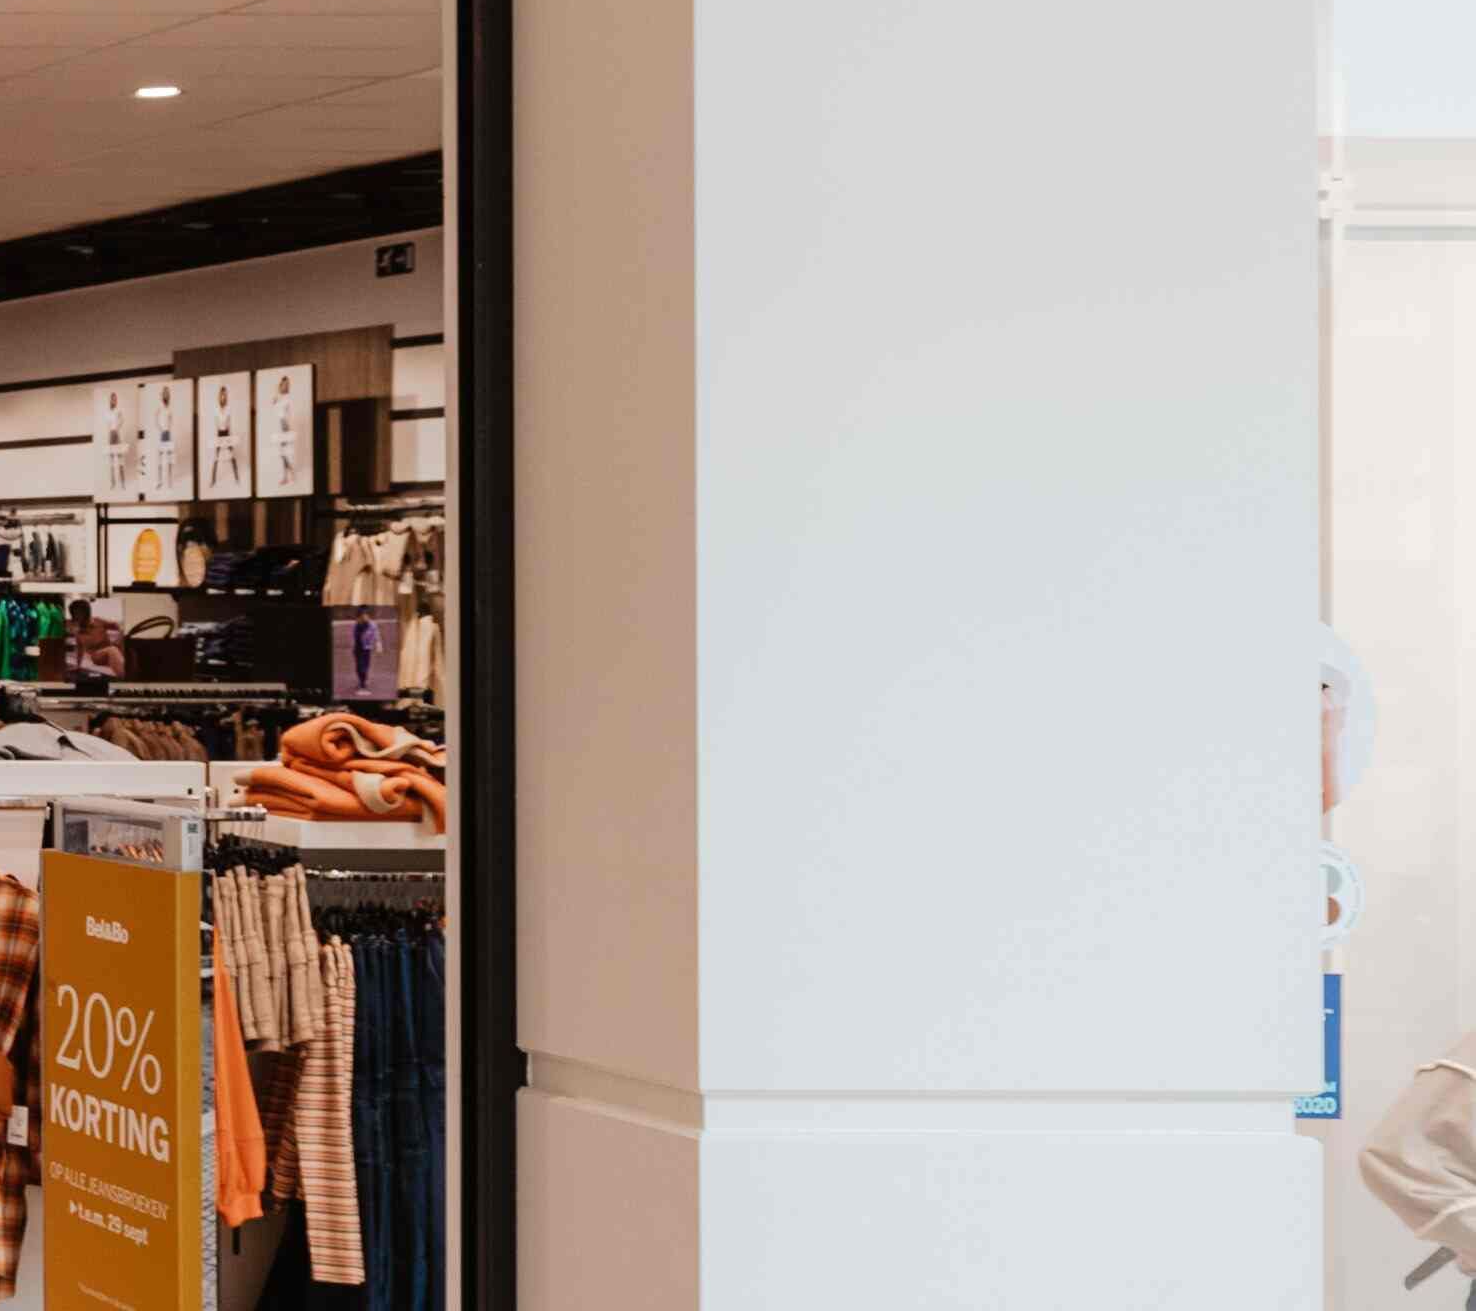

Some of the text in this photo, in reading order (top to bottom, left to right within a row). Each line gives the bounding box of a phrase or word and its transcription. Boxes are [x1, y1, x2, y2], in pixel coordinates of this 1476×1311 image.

[56, 984, 162, 1096] 20%
[50, 1083, 171, 1164] KORTING
[49, 1160, 64, 1180] OP
[64, 1167, 87, 1191] ALLE
[107, 1212, 123, 1235] 29
[123, 1222, 149, 1248] sept
